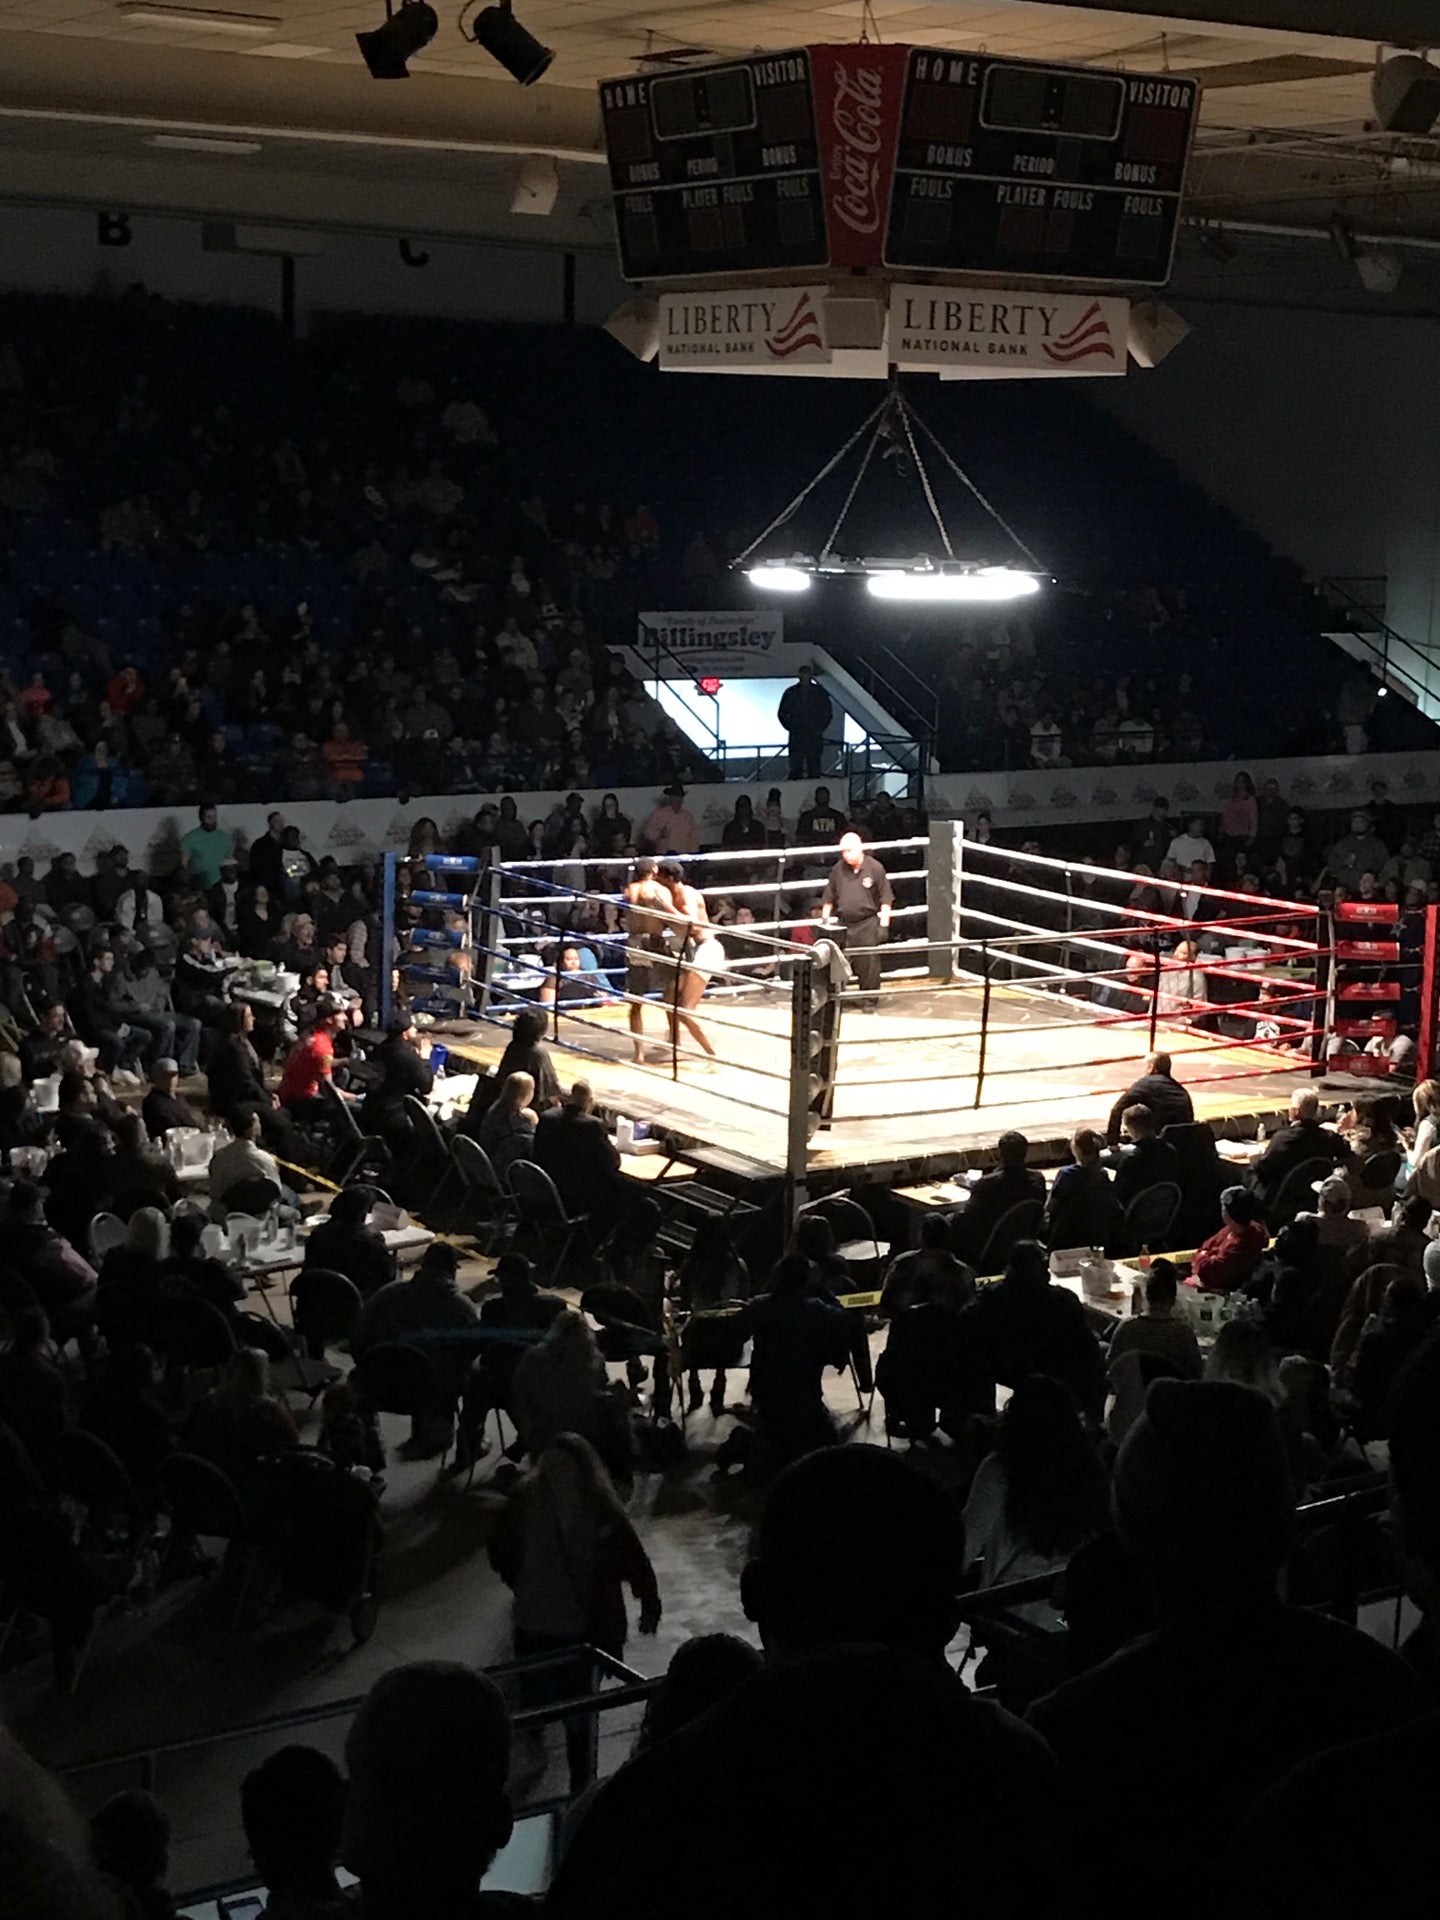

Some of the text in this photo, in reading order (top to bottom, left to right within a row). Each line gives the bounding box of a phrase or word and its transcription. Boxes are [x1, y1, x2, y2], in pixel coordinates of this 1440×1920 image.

[755, 57, 807, 87] VISITOR
[915, 56, 979, 86] HOME
[602, 84, 649, 108] HOME
[1128, 82, 1192, 108] VISITOR
[832, 61, 883, 234] Coca-Cola
[926, 145, 974, 167] BONUS
[1012, 155, 1055, 175] PERIOD
[1114, 162, 1157, 184] BONUS
[910, 176, 954, 199] FOULS
[996, 184, 1094, 210] PLAYER FOULS
[1124, 194, 1164, 216] FOULS
[668, 302, 777, 337] LIBERTY
[905, 298, 1059, 337] LIBERTY
[667, 341, 755, 356] NATIONAL BANK
[901, 338, 1029, 356] NATIONAL BANK
[643, 626, 776, 650] Billingsley
